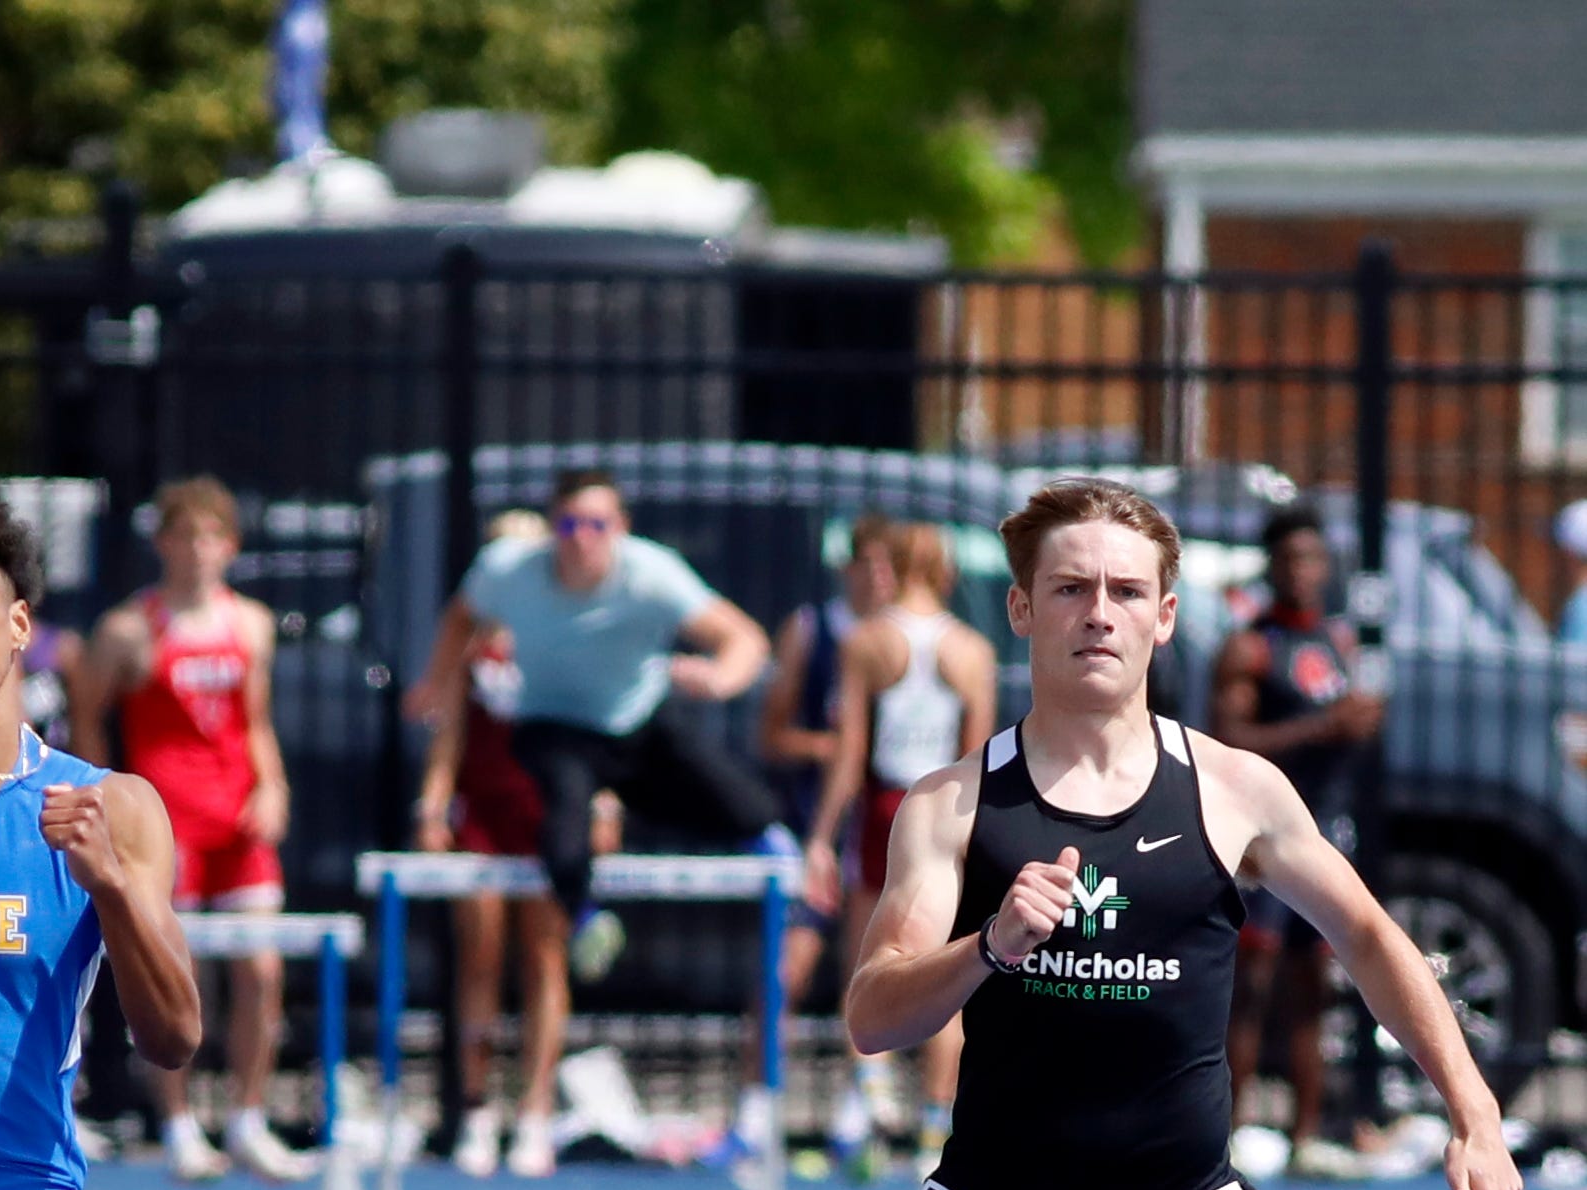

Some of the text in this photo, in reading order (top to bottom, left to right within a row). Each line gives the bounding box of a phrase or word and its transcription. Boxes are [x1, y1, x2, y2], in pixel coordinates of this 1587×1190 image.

[1017, 949, 1180, 980] cNicholas
[1023, 979, 1151, 1001] TRACK & FIELD
